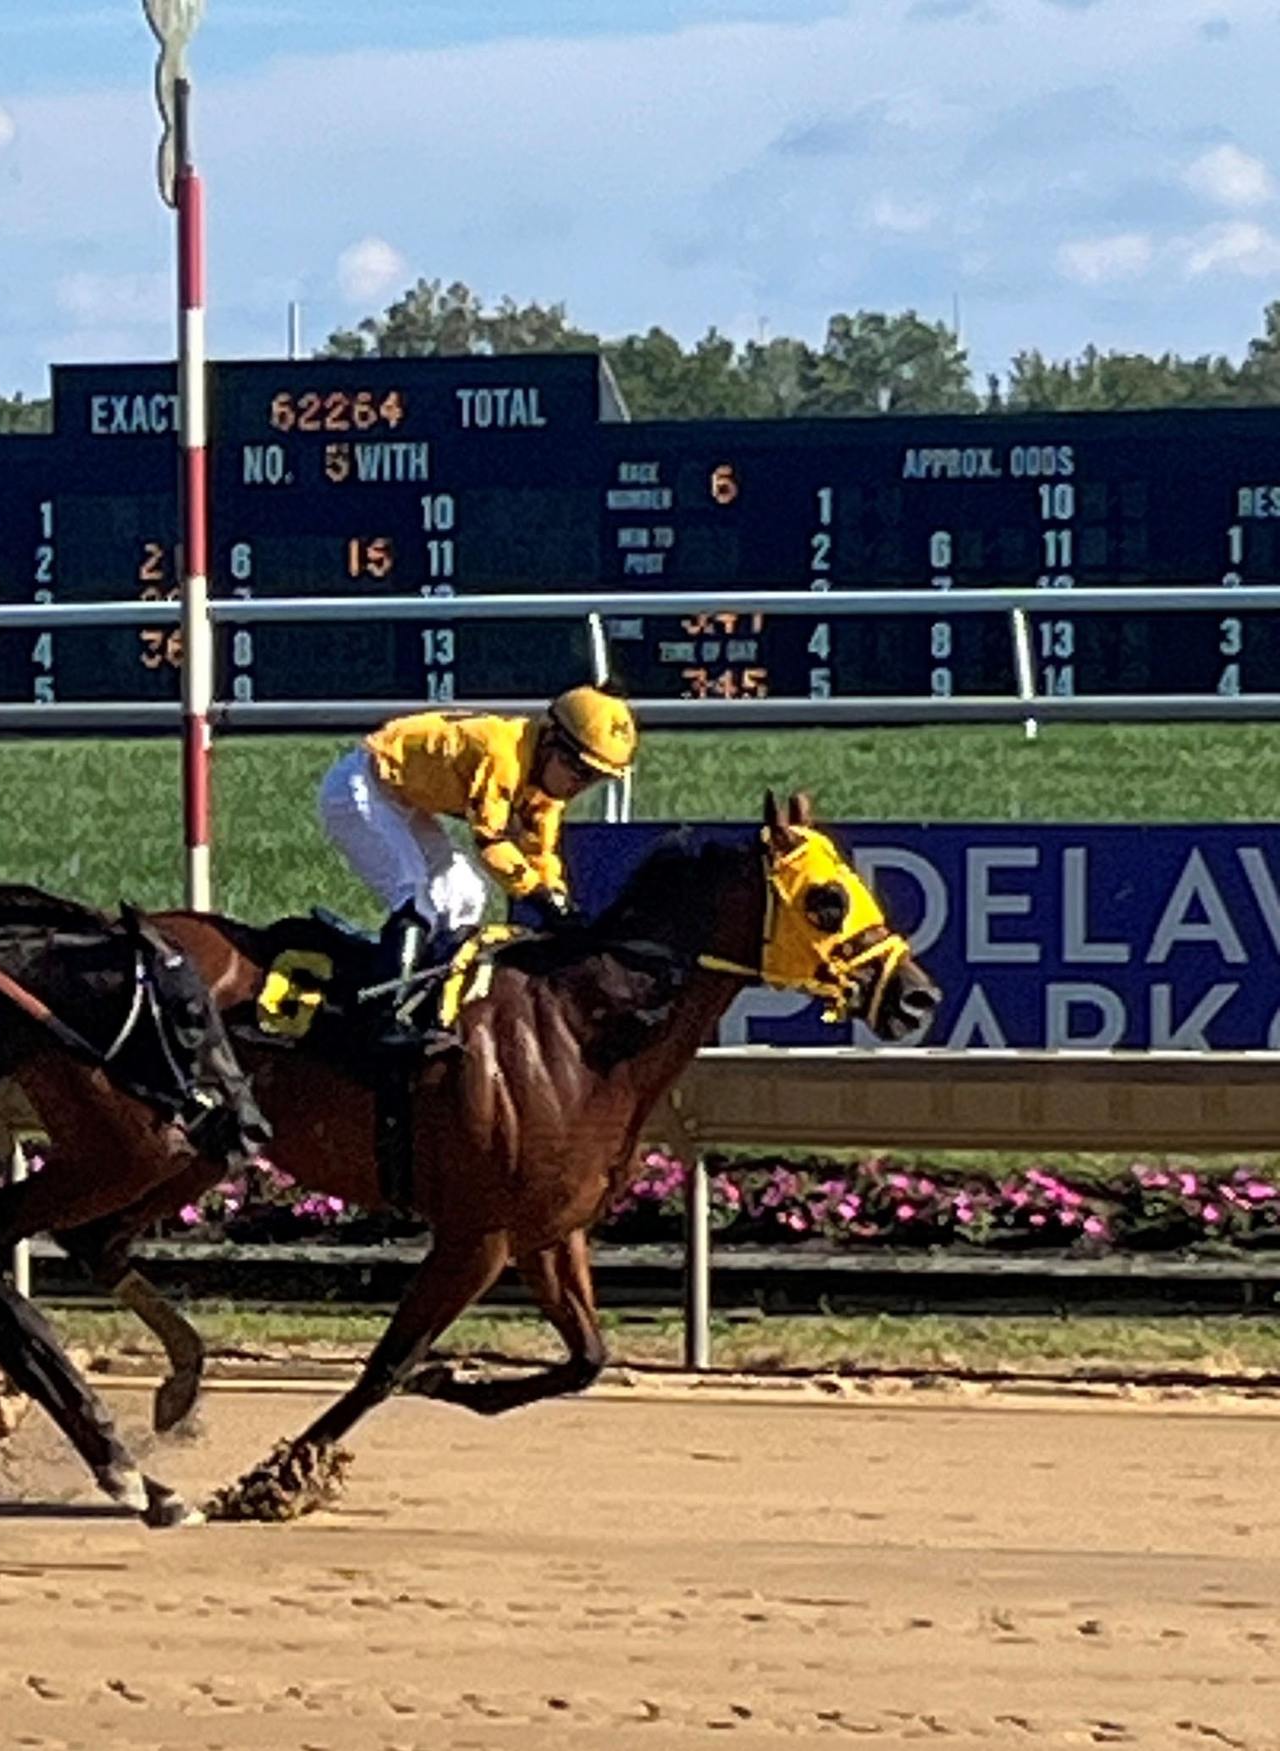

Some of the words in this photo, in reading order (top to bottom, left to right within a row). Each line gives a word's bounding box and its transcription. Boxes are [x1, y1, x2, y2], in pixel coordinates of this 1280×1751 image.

[271, 391, 404, 431] 62264
[456, 387, 547, 428] TOTAL
[243, 445, 294, 484] NO.
[354, 442, 429, 481] WITH
[1010, 446, 1075, 477] ODDS
[711, 464, 738, 504] 6
[1039, 484, 1075, 519] 10
[40, 501, 52, 538] 1
[421, 494, 454, 531] 10
[817, 487, 832, 525] 1
[230, 543, 251, 579] 6
[426, 540, 454, 576] 11
[811, 533, 831, 570] 2
[1042, 530, 1072, 567] 11
[1227, 525, 1243, 564] 1
[35, 546, 53, 582] 2
[32, 632, 52, 670] 4
[422, 629, 454, 665] 13
[808, 623, 831, 660] 4
[931, 622, 951, 658] 8
[1039, 621, 1074, 658] 13
[1219, 617, 1242, 656] 3
[1043, 664, 1075, 698] 14
[1218, 663, 1242, 698] 4
